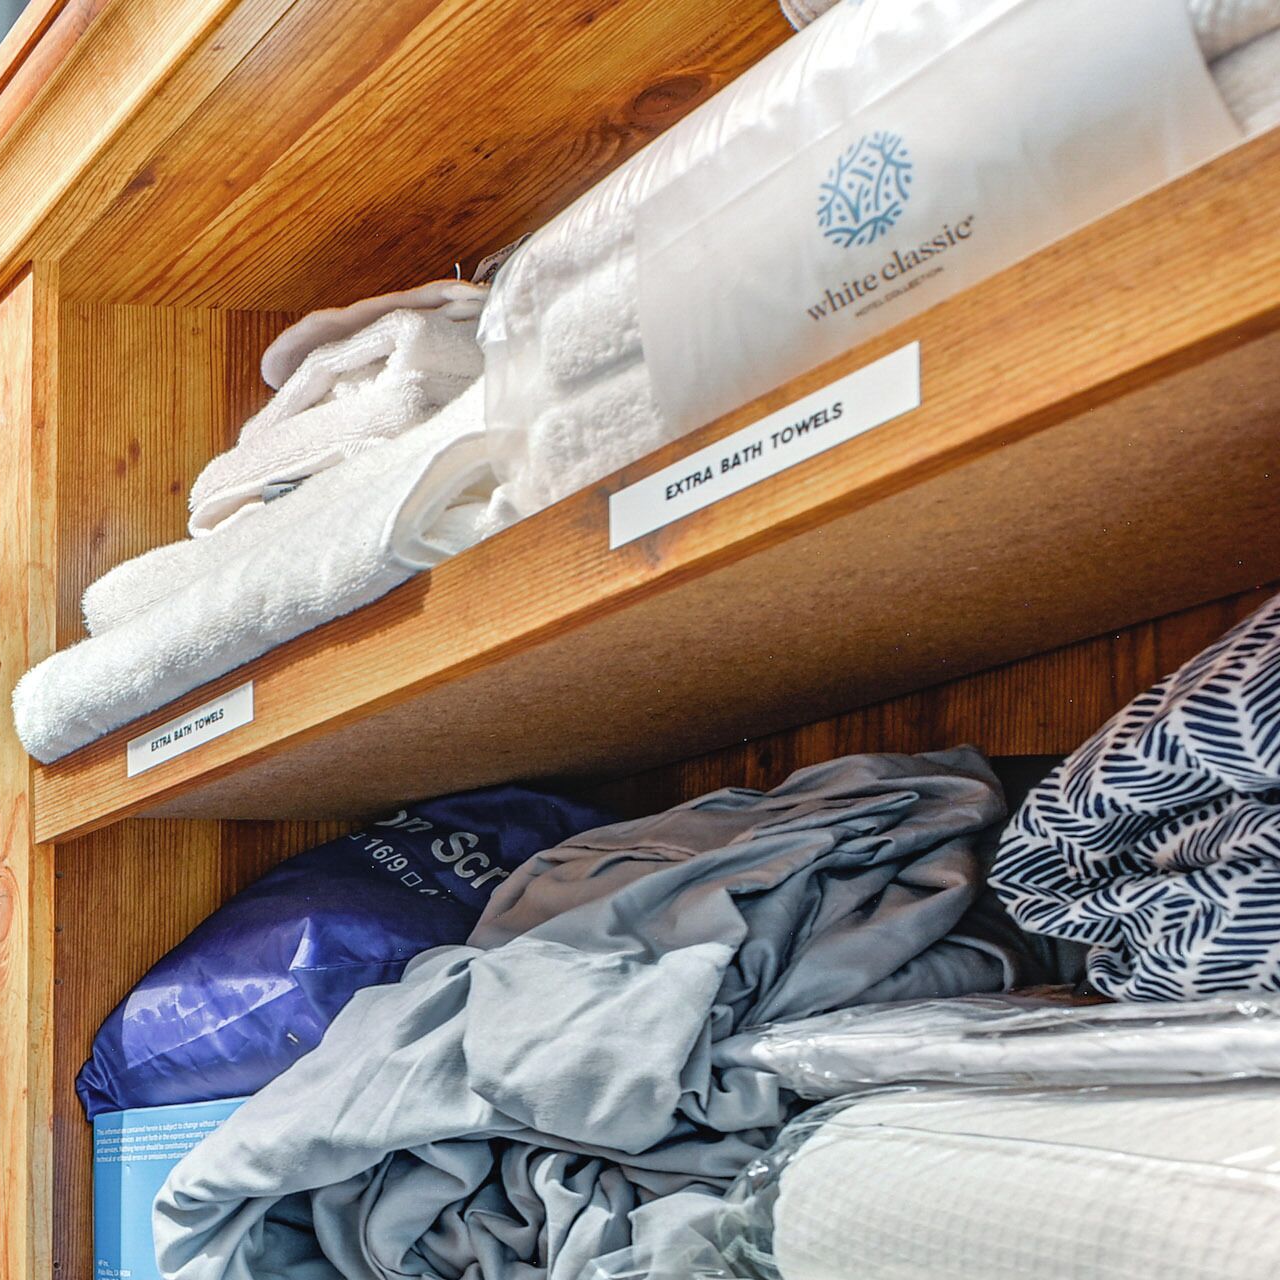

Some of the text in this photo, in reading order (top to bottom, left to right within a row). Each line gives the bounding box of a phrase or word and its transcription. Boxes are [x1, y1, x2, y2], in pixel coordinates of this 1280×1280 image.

[806, 272, 878, 321] white
[665, 401, 843, 500] EXTRA BATH TOWELS
[151, 708, 224, 752] EXTRA BATH TOWELS
[364, 838, 408, 872] 16/9
